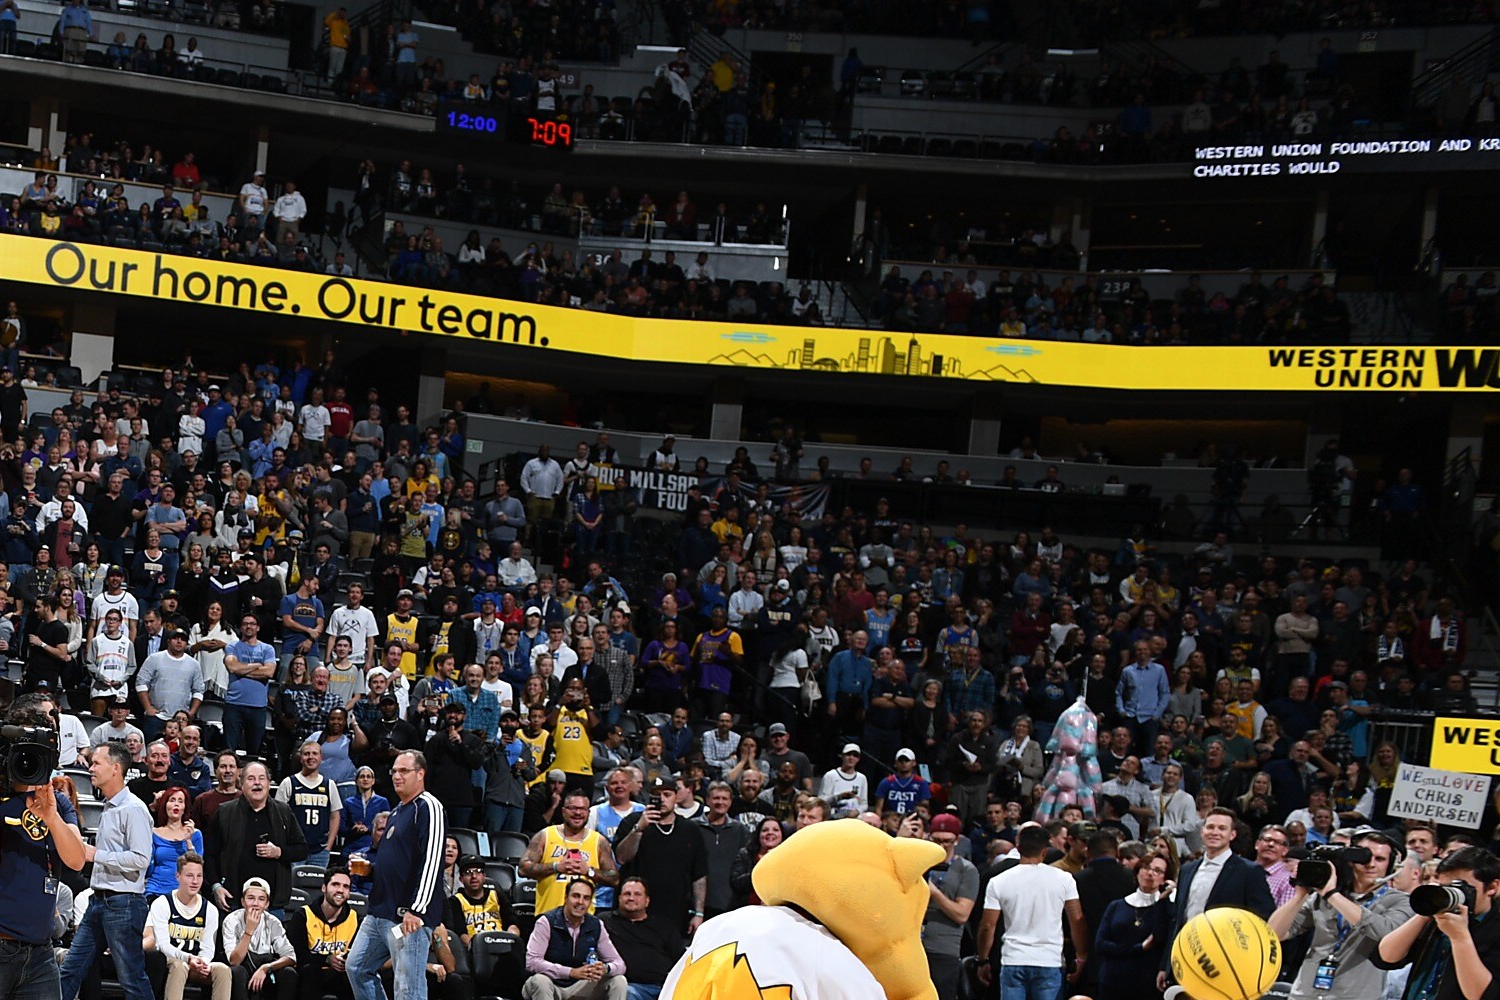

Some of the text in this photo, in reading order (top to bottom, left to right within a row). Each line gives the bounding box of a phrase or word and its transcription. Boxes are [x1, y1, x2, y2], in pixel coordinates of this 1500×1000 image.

[447, 110, 498, 134] 12:00
[528, 117, 572, 148] 7:09
[1195, 138, 1500, 160] WESTERN UNION FOUNDATION AND KR
[1193, 161, 1341, 178] CHARITIES WOULD
[45, 242, 550, 347] Our home. Our team.
[1269, 349, 1425, 367] WESTERN
[1315, 369, 1423, 388] UNION
[563, 726, 581, 740] 23
[1402, 769, 1423, 783] WE
[1443, 775, 1485, 792] LOVE
[295, 793, 328, 807] DENVER
[888, 790, 916, 801] EAST
[1415, 788, 1463, 806] CHRIS
[304, 809, 319, 825] 15
[897, 801, 906, 815] 6
[1392, 800, 1479, 823] ANDERSEN
[1197, 952, 1220, 978] WU
